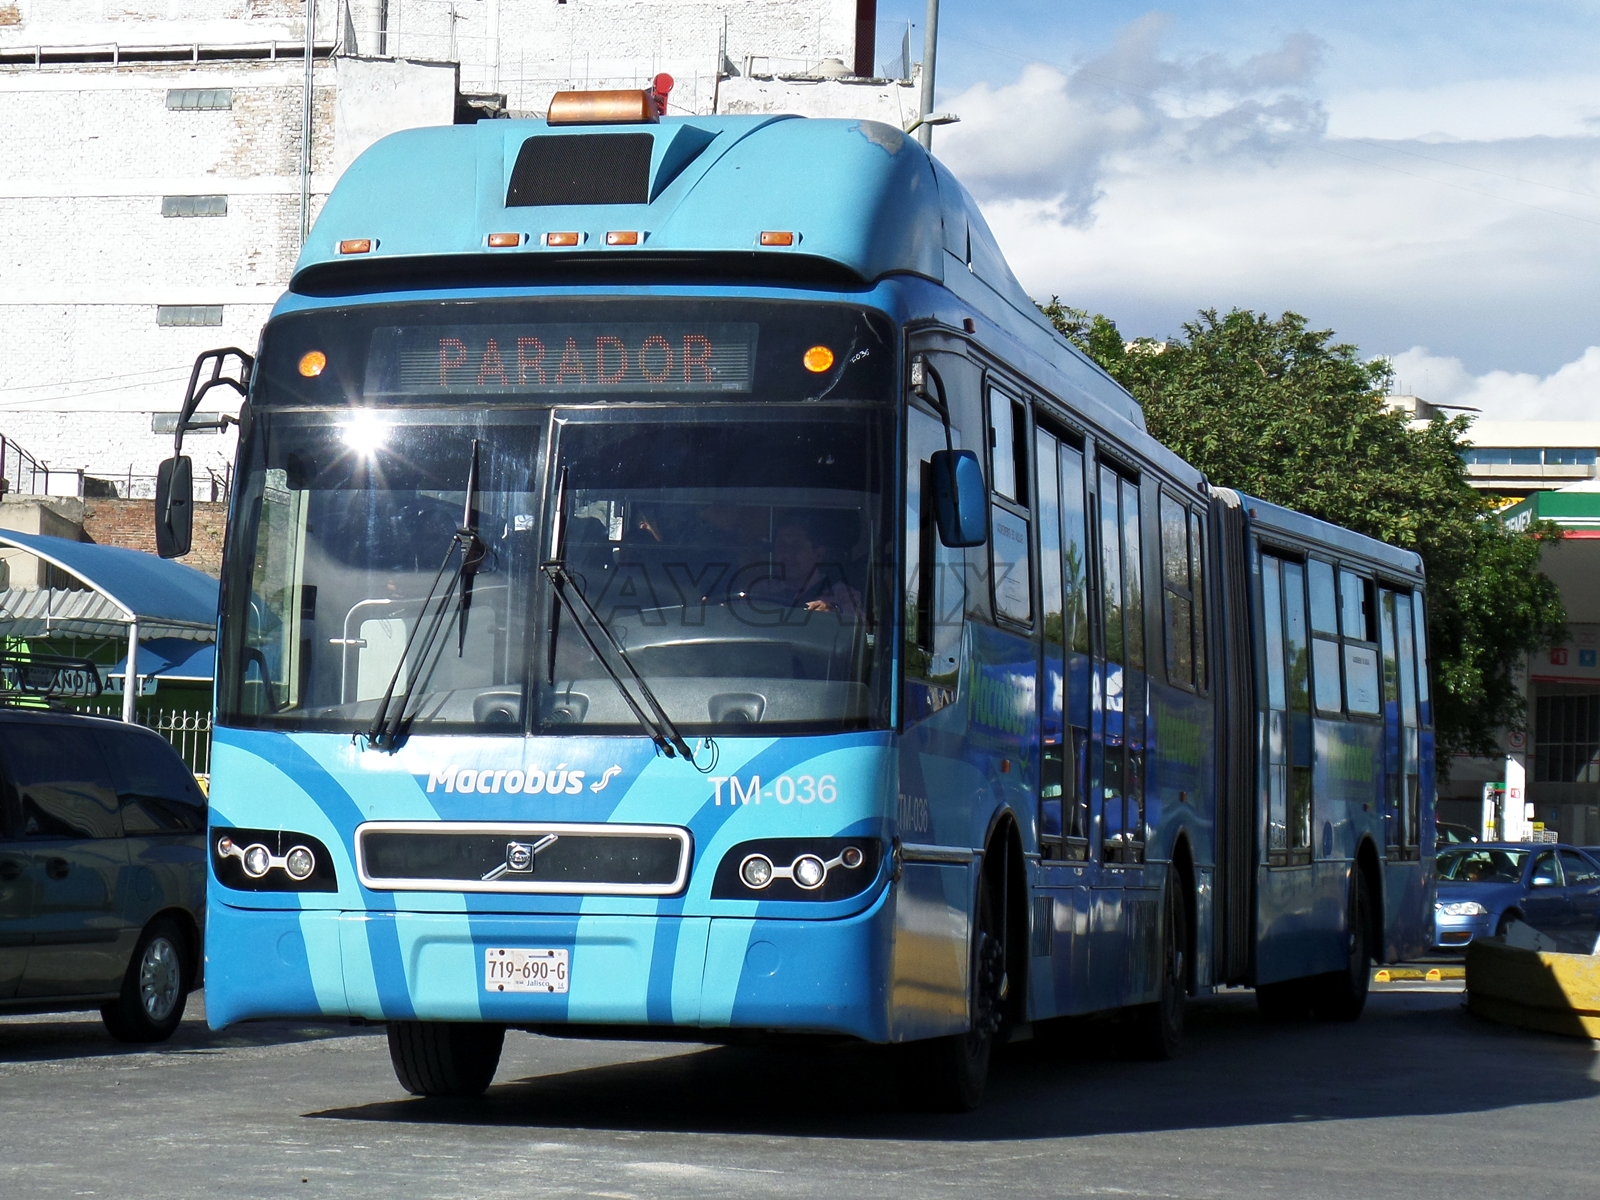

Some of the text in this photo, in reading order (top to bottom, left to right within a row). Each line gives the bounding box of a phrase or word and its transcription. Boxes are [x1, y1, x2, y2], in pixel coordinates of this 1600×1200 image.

[439, 334, 713, 387] PARADOR
[427, 763, 585, 795] Macrobús
[708, 774, 838, 807] TM-036
[898, 793, 929, 833] TM-036
[488, 960, 566, 980] 719-690-G
[526, 979, 550, 987] Jalisco
